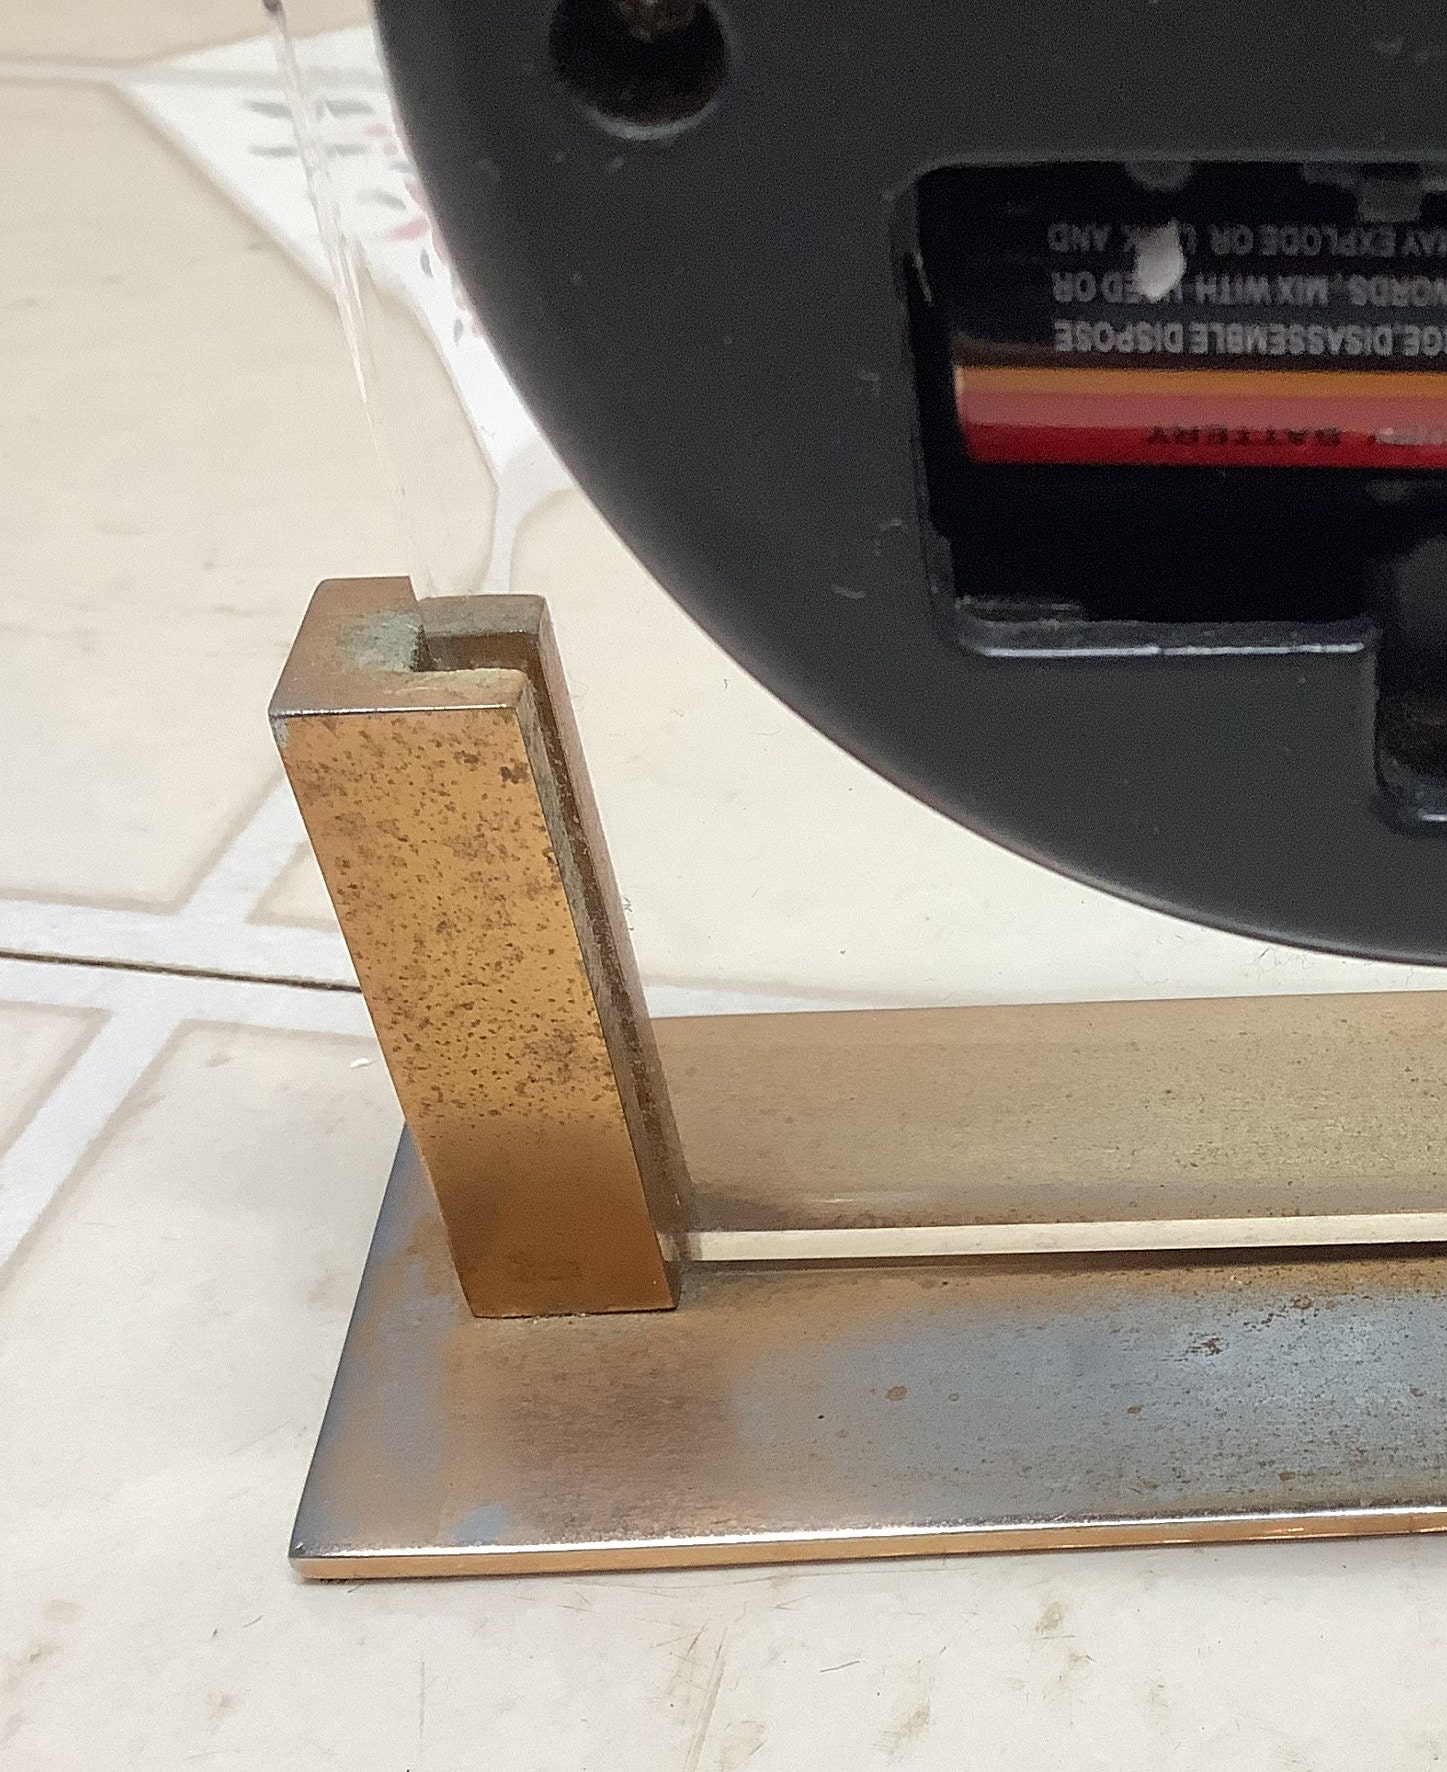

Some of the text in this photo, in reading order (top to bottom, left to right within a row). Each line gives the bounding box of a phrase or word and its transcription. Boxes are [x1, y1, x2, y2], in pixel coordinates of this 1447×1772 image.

[1047, 222, 1113, 253] AND
[1209, 224, 1254, 256] OR
[1259, 225, 1397, 258] EXPLODE
[1052, 270, 1096, 303] OR
[1194, 272, 1271, 305] WITH
[1277, 273, 1330, 306] MIX
[1053, 320, 1184, 354] DISPOSE
